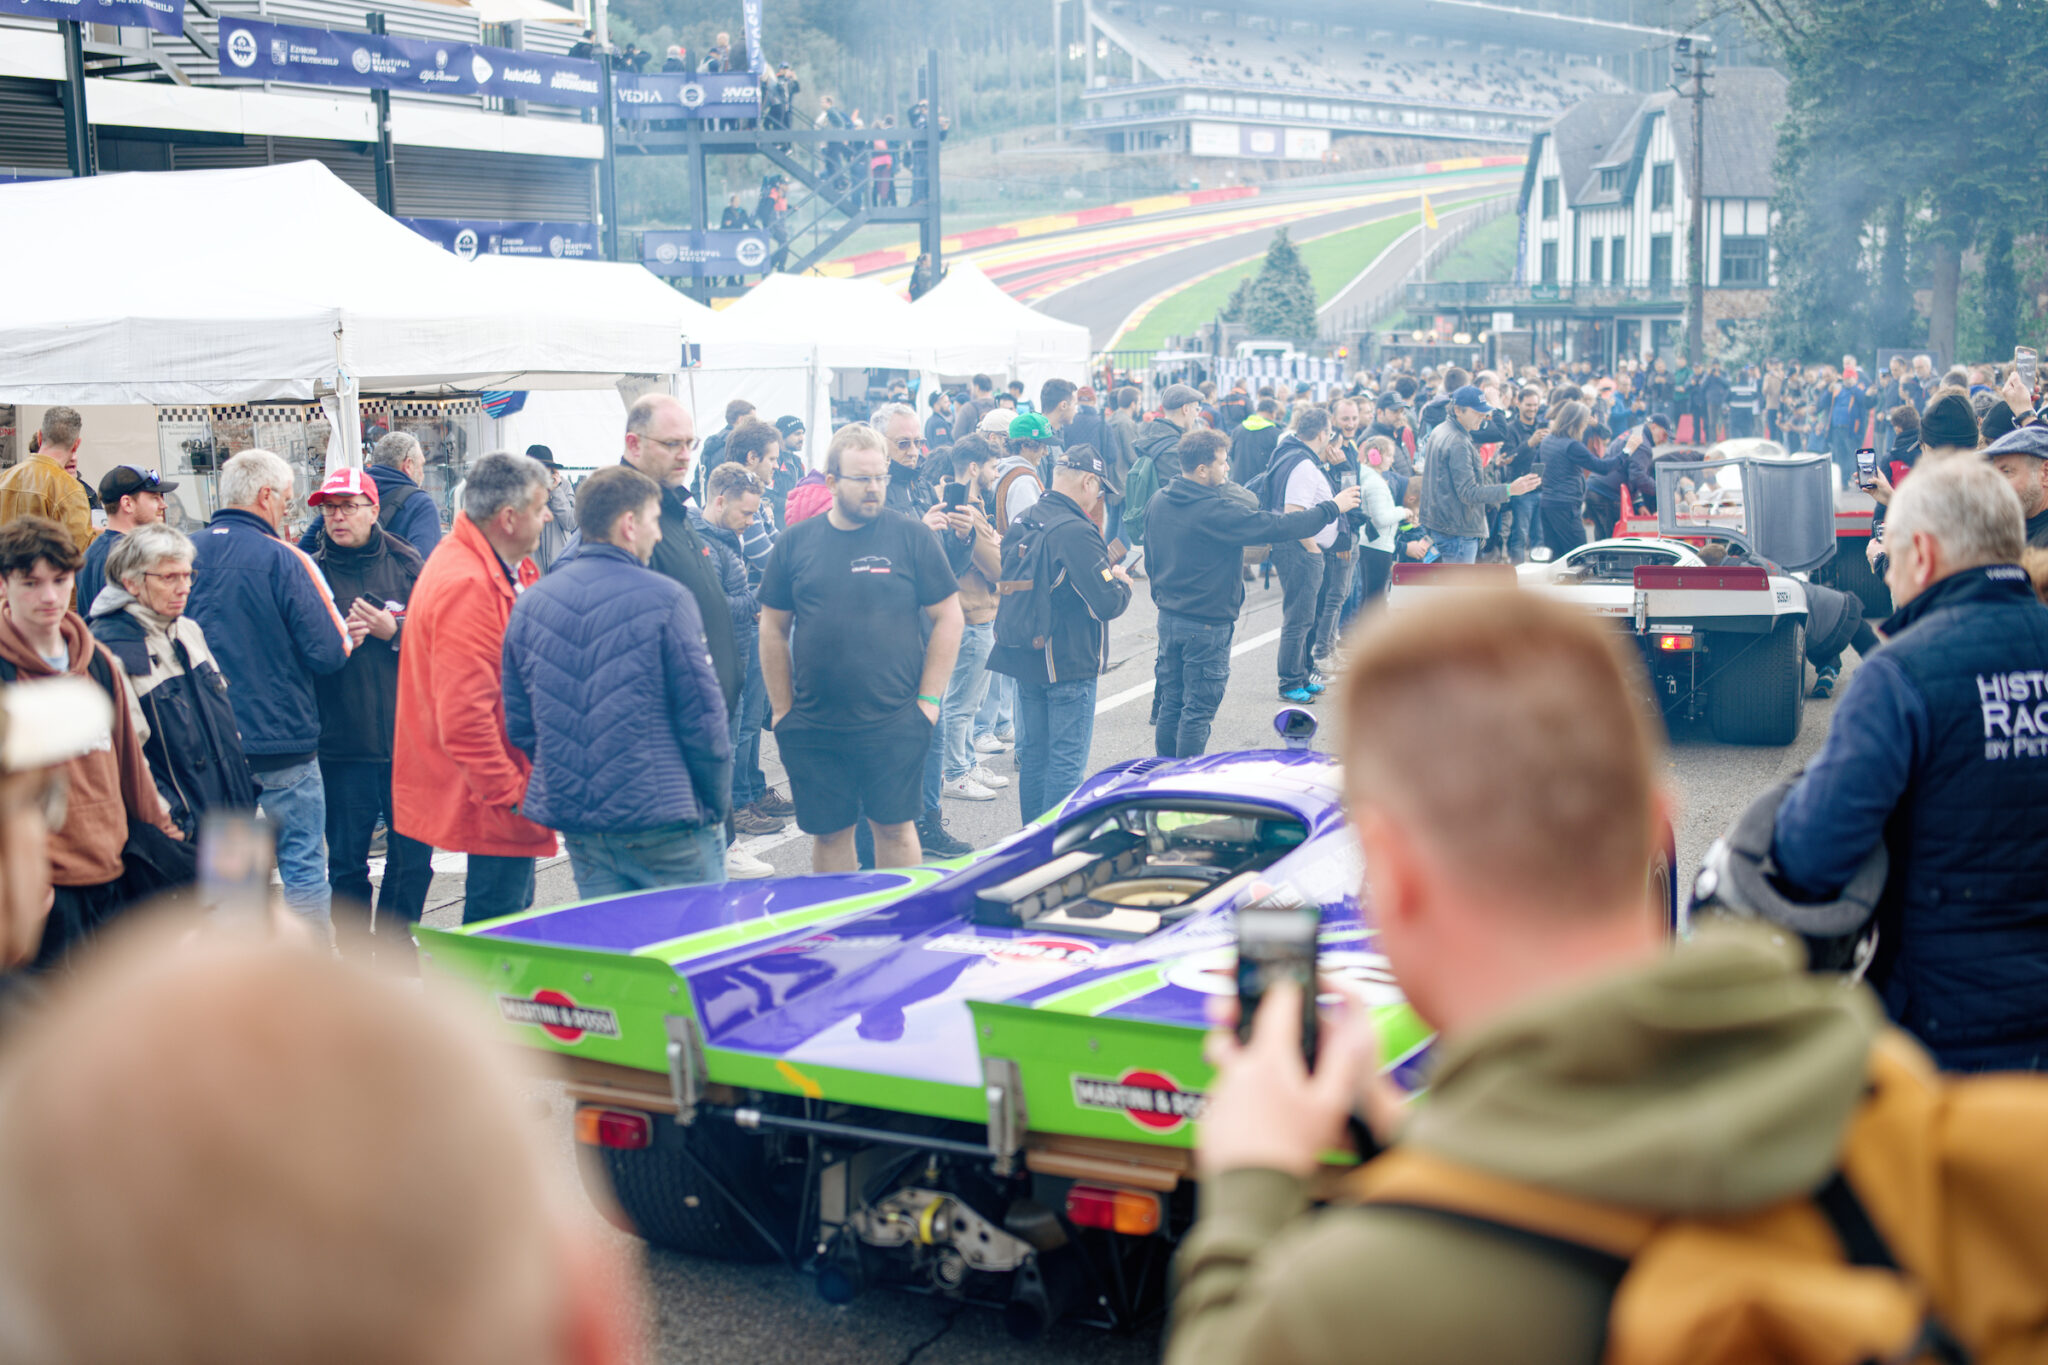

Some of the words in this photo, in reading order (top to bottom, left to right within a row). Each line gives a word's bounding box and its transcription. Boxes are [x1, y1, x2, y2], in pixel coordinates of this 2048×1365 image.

[371, 57, 410, 68] BEAUTIFUL
[618, 88, 663, 103] VEDIA
[1079, 1083, 1154, 1111] MARTINI
[1156, 1093, 1169, 1112] &
